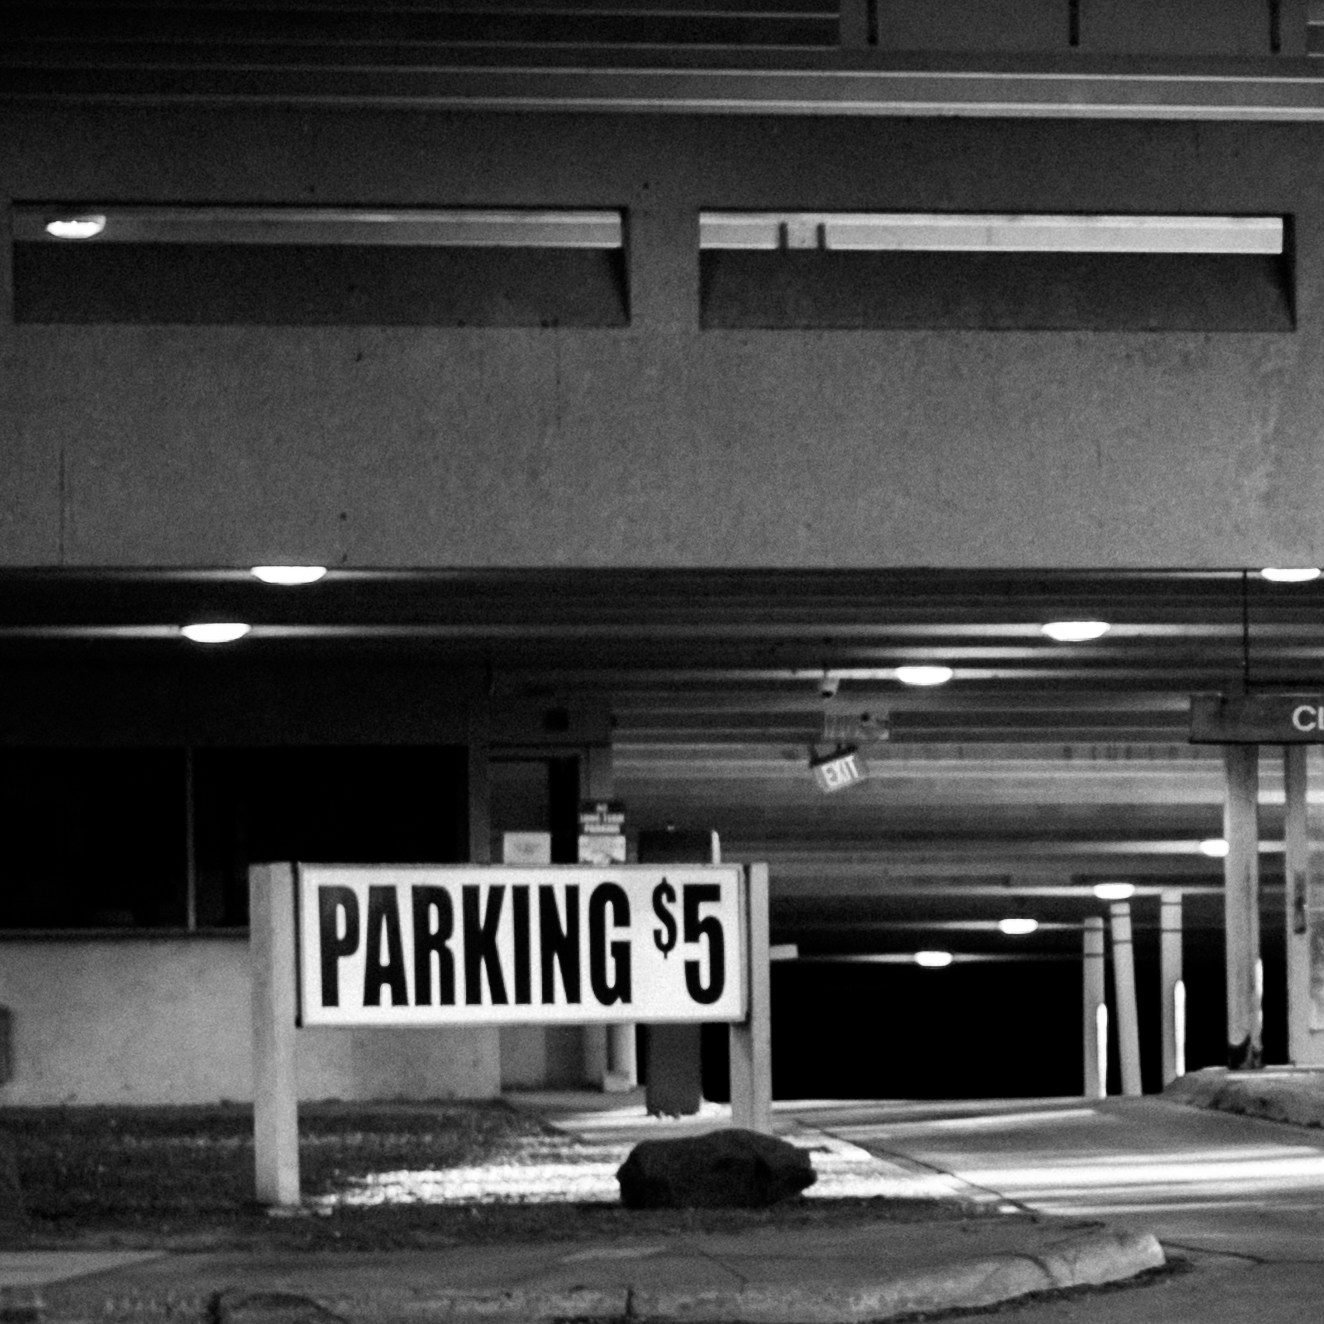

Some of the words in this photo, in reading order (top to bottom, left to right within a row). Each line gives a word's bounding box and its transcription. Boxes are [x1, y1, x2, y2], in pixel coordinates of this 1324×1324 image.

[821, 754, 859, 788] EXIT
[317, 881, 632, 1007] PARKING
[651, 876, 725, 1005] $5
